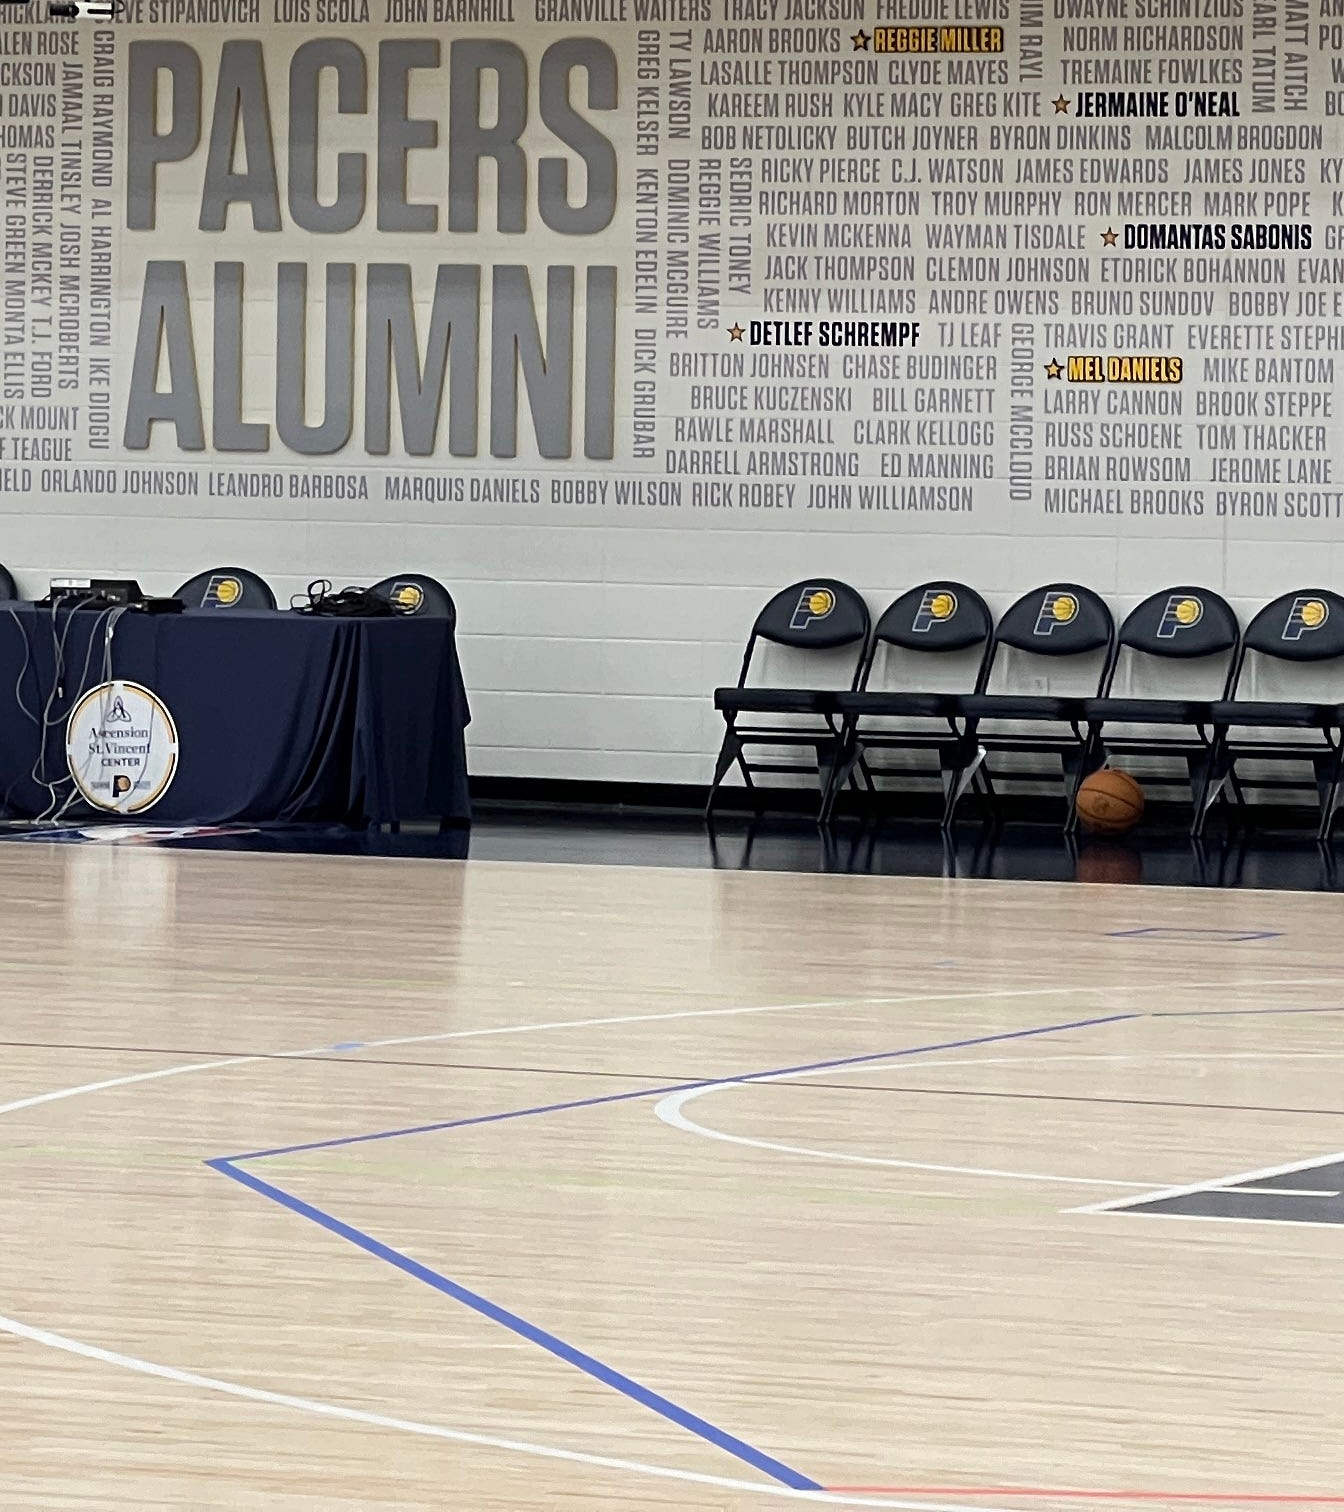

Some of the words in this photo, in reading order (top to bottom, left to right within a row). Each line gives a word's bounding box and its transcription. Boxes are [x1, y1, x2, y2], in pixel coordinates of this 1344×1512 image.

[273, 0, 311, 23] LUIS
[316, 0, 370, 23] SCOLA
[383, 0, 428, 23] JOHN
[37, 31, 80, 55] ROSE
[874, 27, 938, 52] REGGIE
[940, 27, 1003, 52] MILLER
[1284, 51, 1309, 112] AITCH
[1073, 92, 1169, 117] JERMAINE
[1175, 92, 1240, 117] O'NEAL
[126, 37, 618, 235] PACERS
[1145, 125, 1233, 150] MALCOLM
[1237, 125, 1323, 150] BROGDON
[1124, 224, 1226, 249] DOMANTAS
[1230, 224, 1312, 249] SABONIS
[750, 321, 813, 345] DETLEF
[818, 322, 920, 346] SCHREMPF
[123, 260, 617, 461] ALUMNI
[1067, 357, 1103, 382] MEL
[1107, 357, 1182, 382] DANIELS
[853, 420, 911, 445] CLARK
[916, 421, 994, 446] KELLOGG
[10, 438, 72, 461] TEAGUE
[208, 473, 284, 497] LEANDRO
[289, 475, 368, 499] BARBOSA
[692, 482, 733, 507] RICK
[738, 483, 796, 507] ROBEY
[1216, 492, 1278, 516] BYRON
[1284, 492, 1343, 517] SCOTT
[101, 758, 140, 767] CENTER
